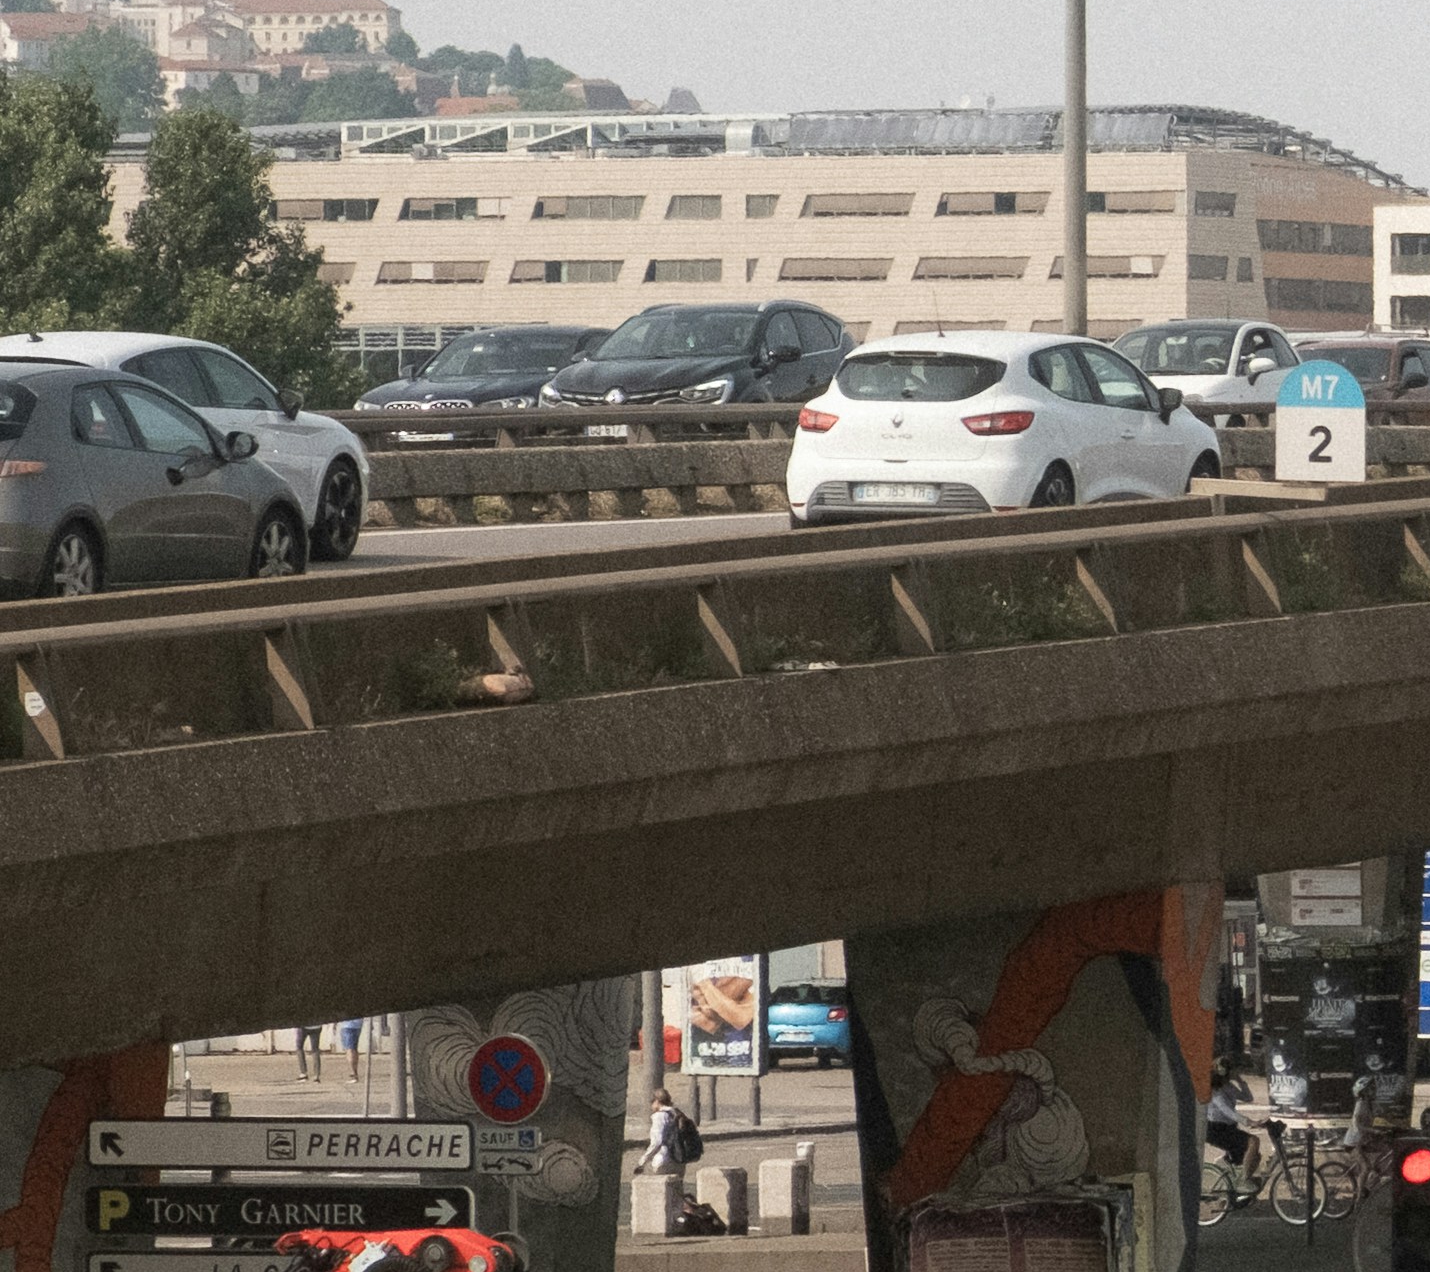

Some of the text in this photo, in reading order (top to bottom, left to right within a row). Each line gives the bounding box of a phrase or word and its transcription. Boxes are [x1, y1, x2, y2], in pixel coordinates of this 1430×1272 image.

[1301, 374, 1340, 401] M7
[1308, 424, 1333, 463] 2
[307, 1132, 463, 1160] PERRACHE
[479, 1132, 515, 1145] SAUF
[146, 1197, 222, 1225] TONY
[240, 1197, 366, 1226] GARNIER
